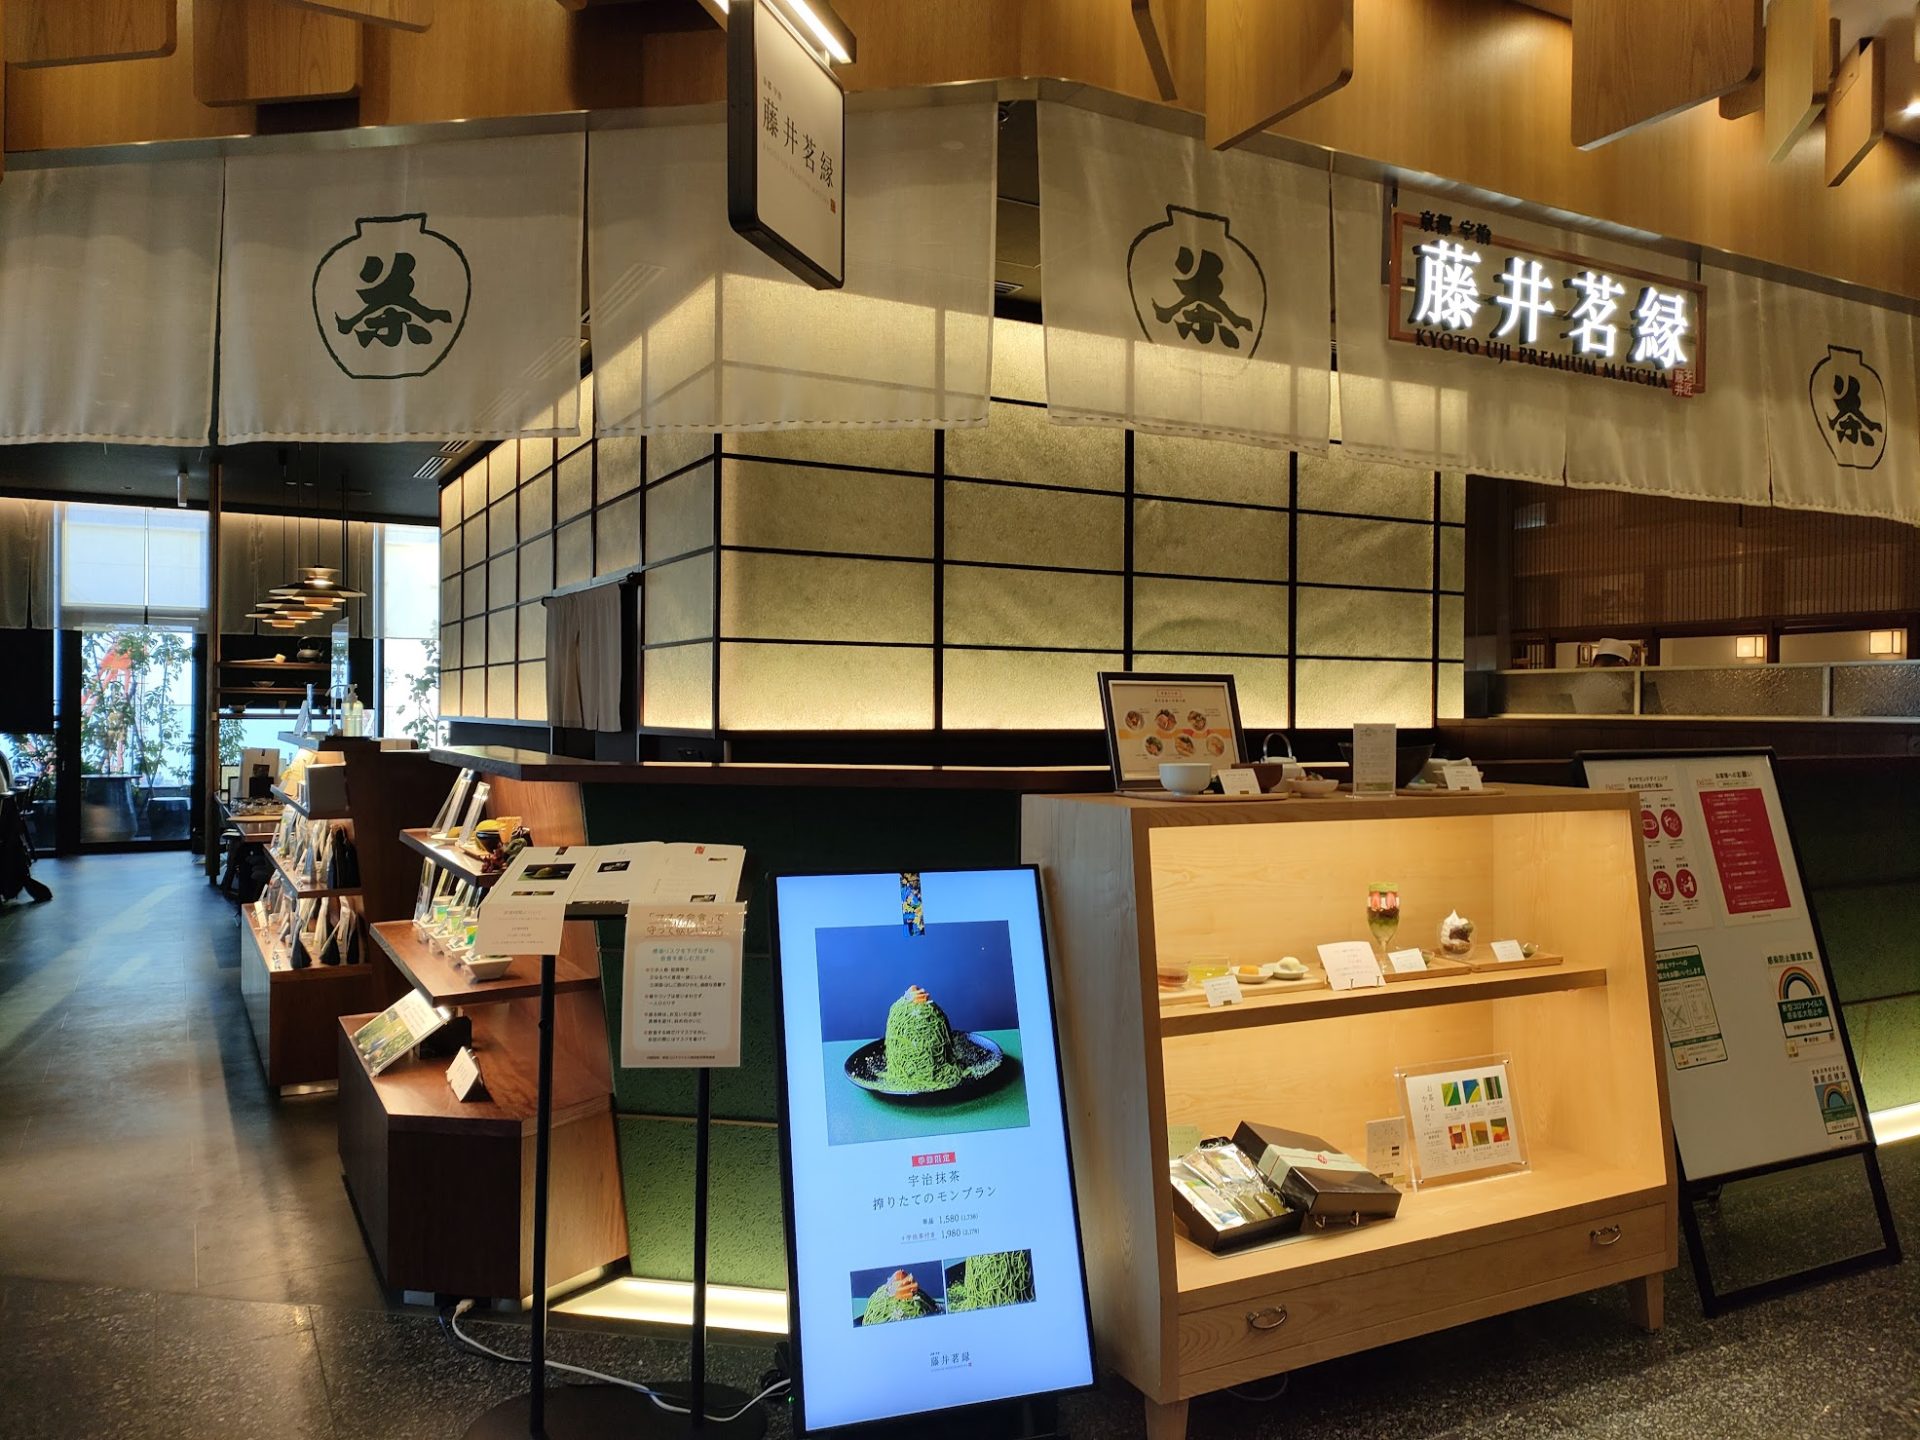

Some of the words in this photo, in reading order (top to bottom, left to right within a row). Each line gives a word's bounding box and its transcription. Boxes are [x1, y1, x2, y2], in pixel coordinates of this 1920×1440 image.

[763, 96, 834, 188] 藤井茗縁
[335, 252, 452, 349] 茶
[1152, 246, 1254, 349] 茶
[1411, 239, 1690, 370] 藤井茗縁
[1415, 328, 1480, 355] KYOTO
[1485, 341, 1511, 364] UJI
[1518, 346, 1597, 377] PREMIUM
[1603, 362, 1669, 389] MATCHA
[1825, 374, 1883, 447] 茶
[873, 1186, 996, 1211] 搾りたてのモンブラン
[908, 1170, 960, 1187] 宇治抹茶
[938, 1214, 960, 1225] 1,580
[941, 1228, 962, 1240] 1,980
